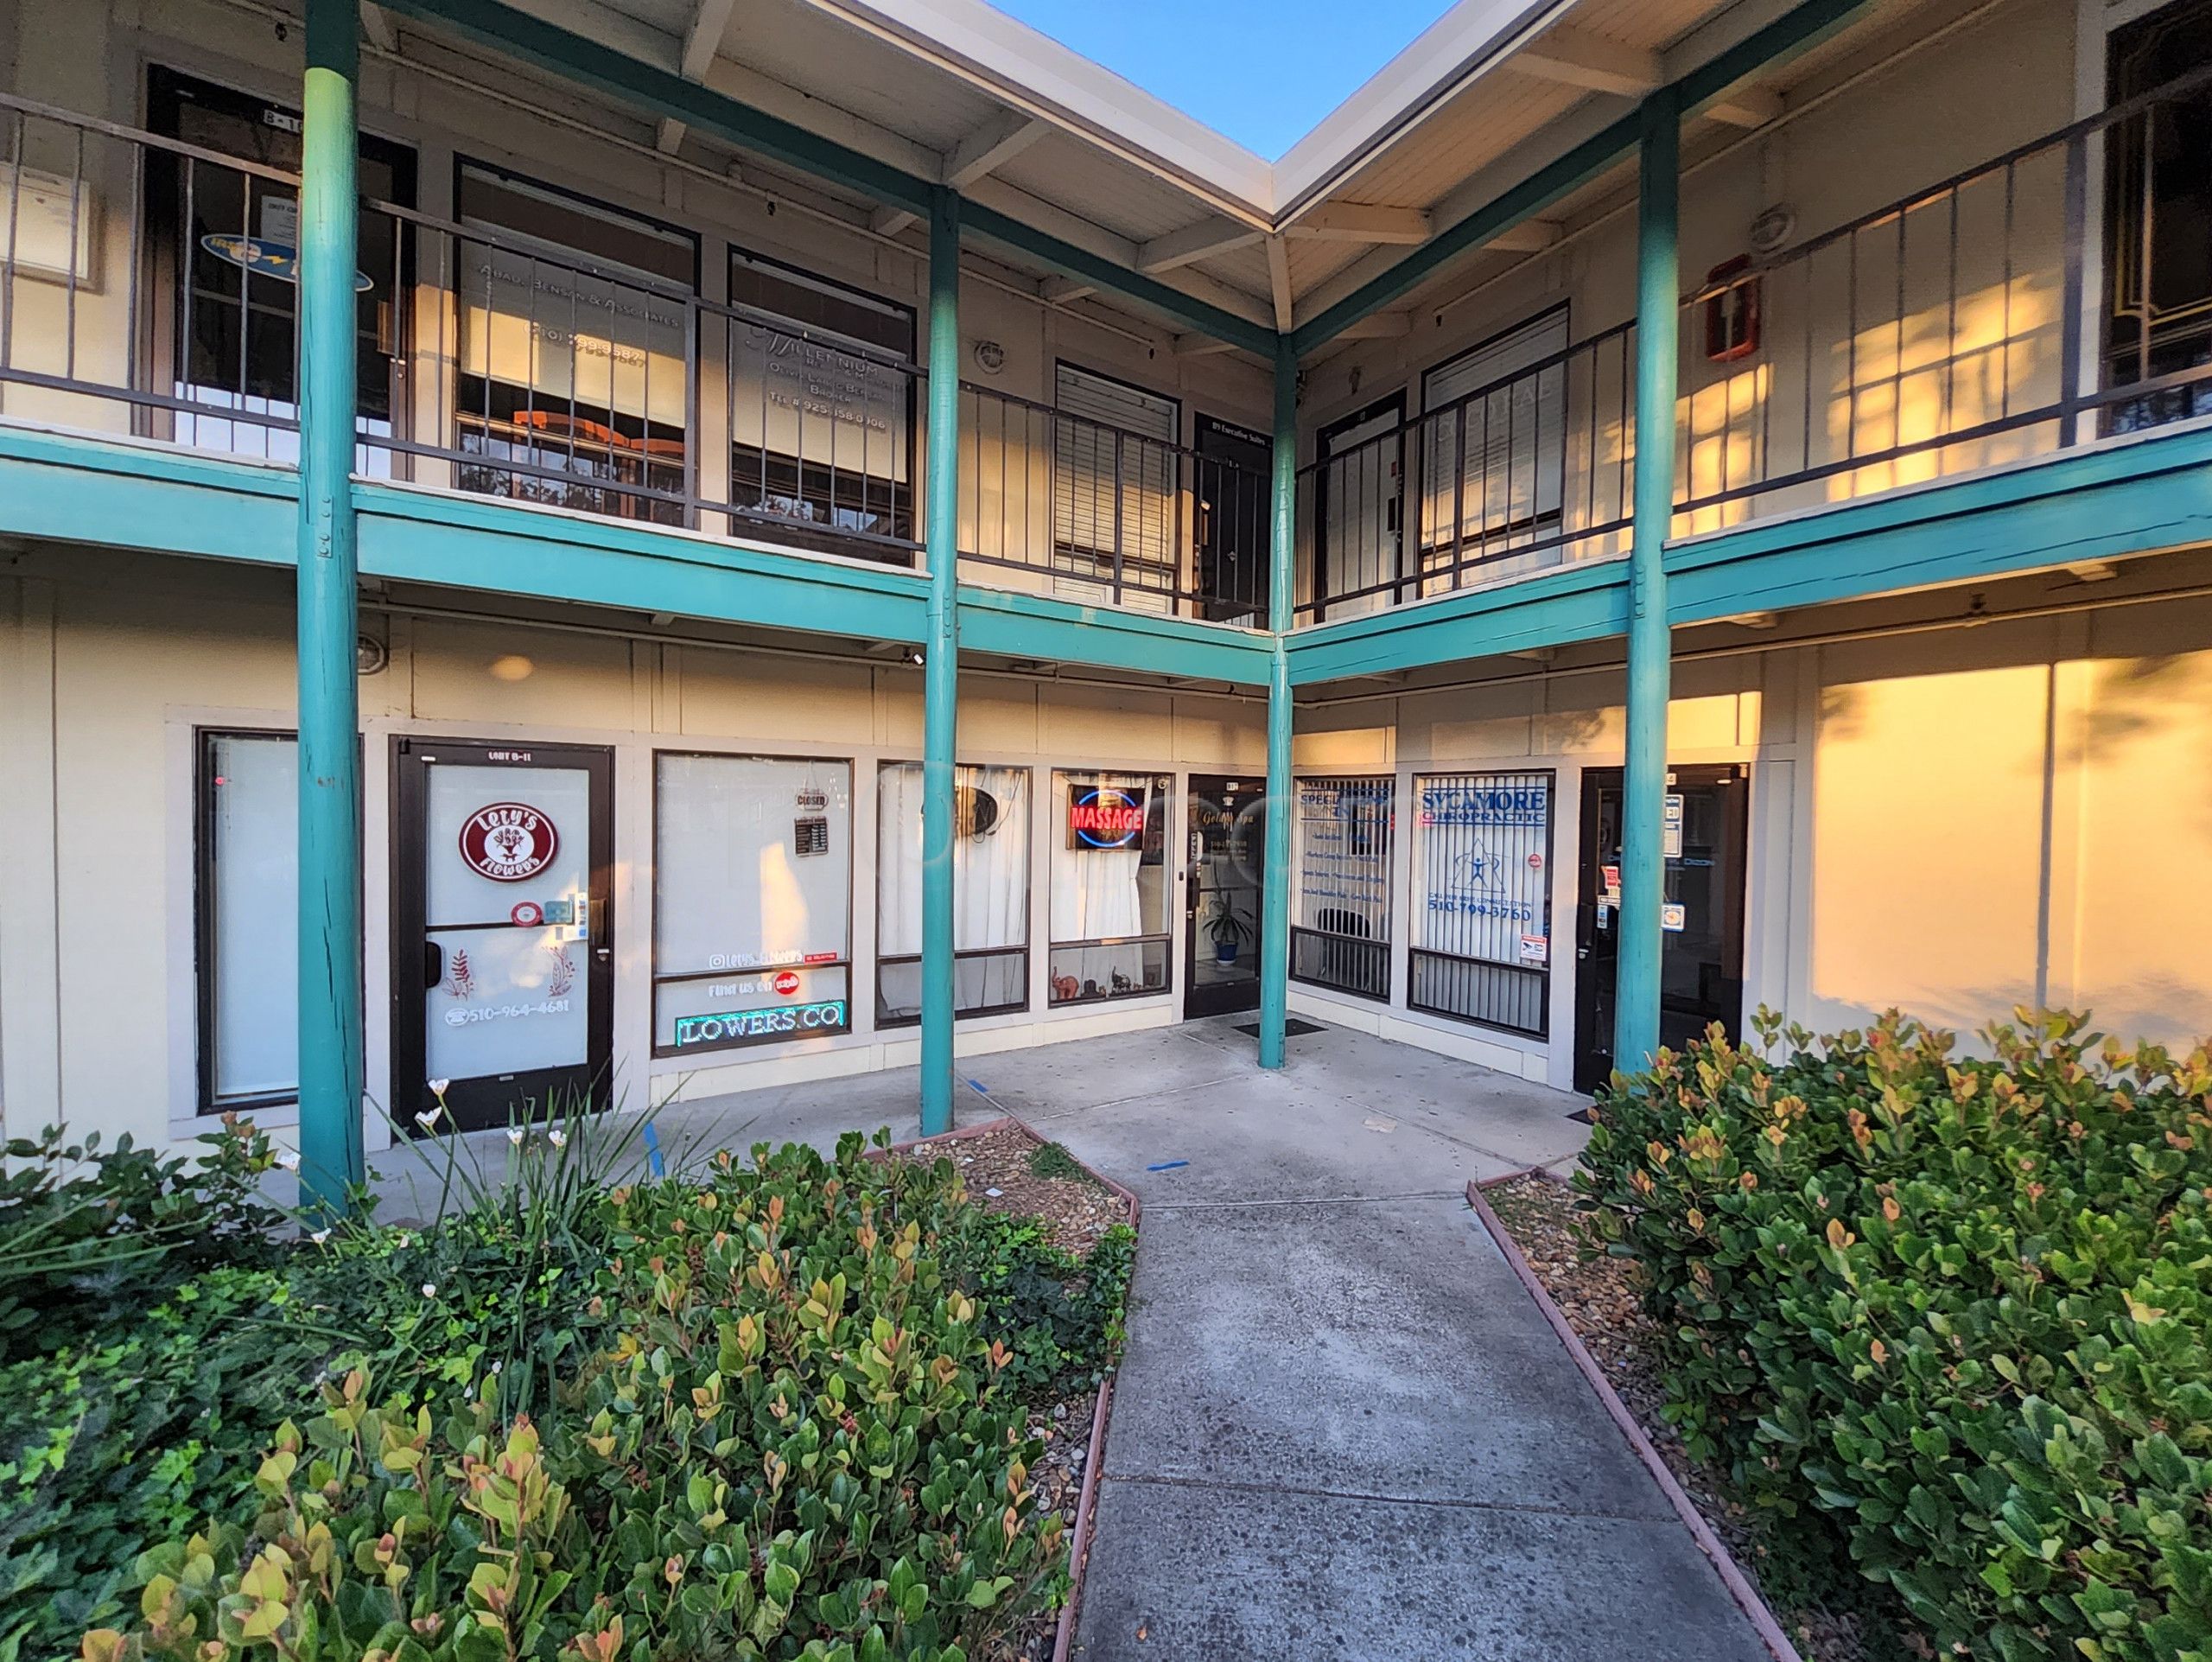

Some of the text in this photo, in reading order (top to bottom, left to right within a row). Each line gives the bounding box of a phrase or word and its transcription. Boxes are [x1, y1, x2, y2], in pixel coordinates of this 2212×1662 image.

[605, 299, 679, 328] ASSOCATES
[1422, 792, 1546, 811] SYCAMORE
[1071, 806, 1143, 830] MASSAGE
[1422, 812, 1545, 822] CHIROPRACTIC
